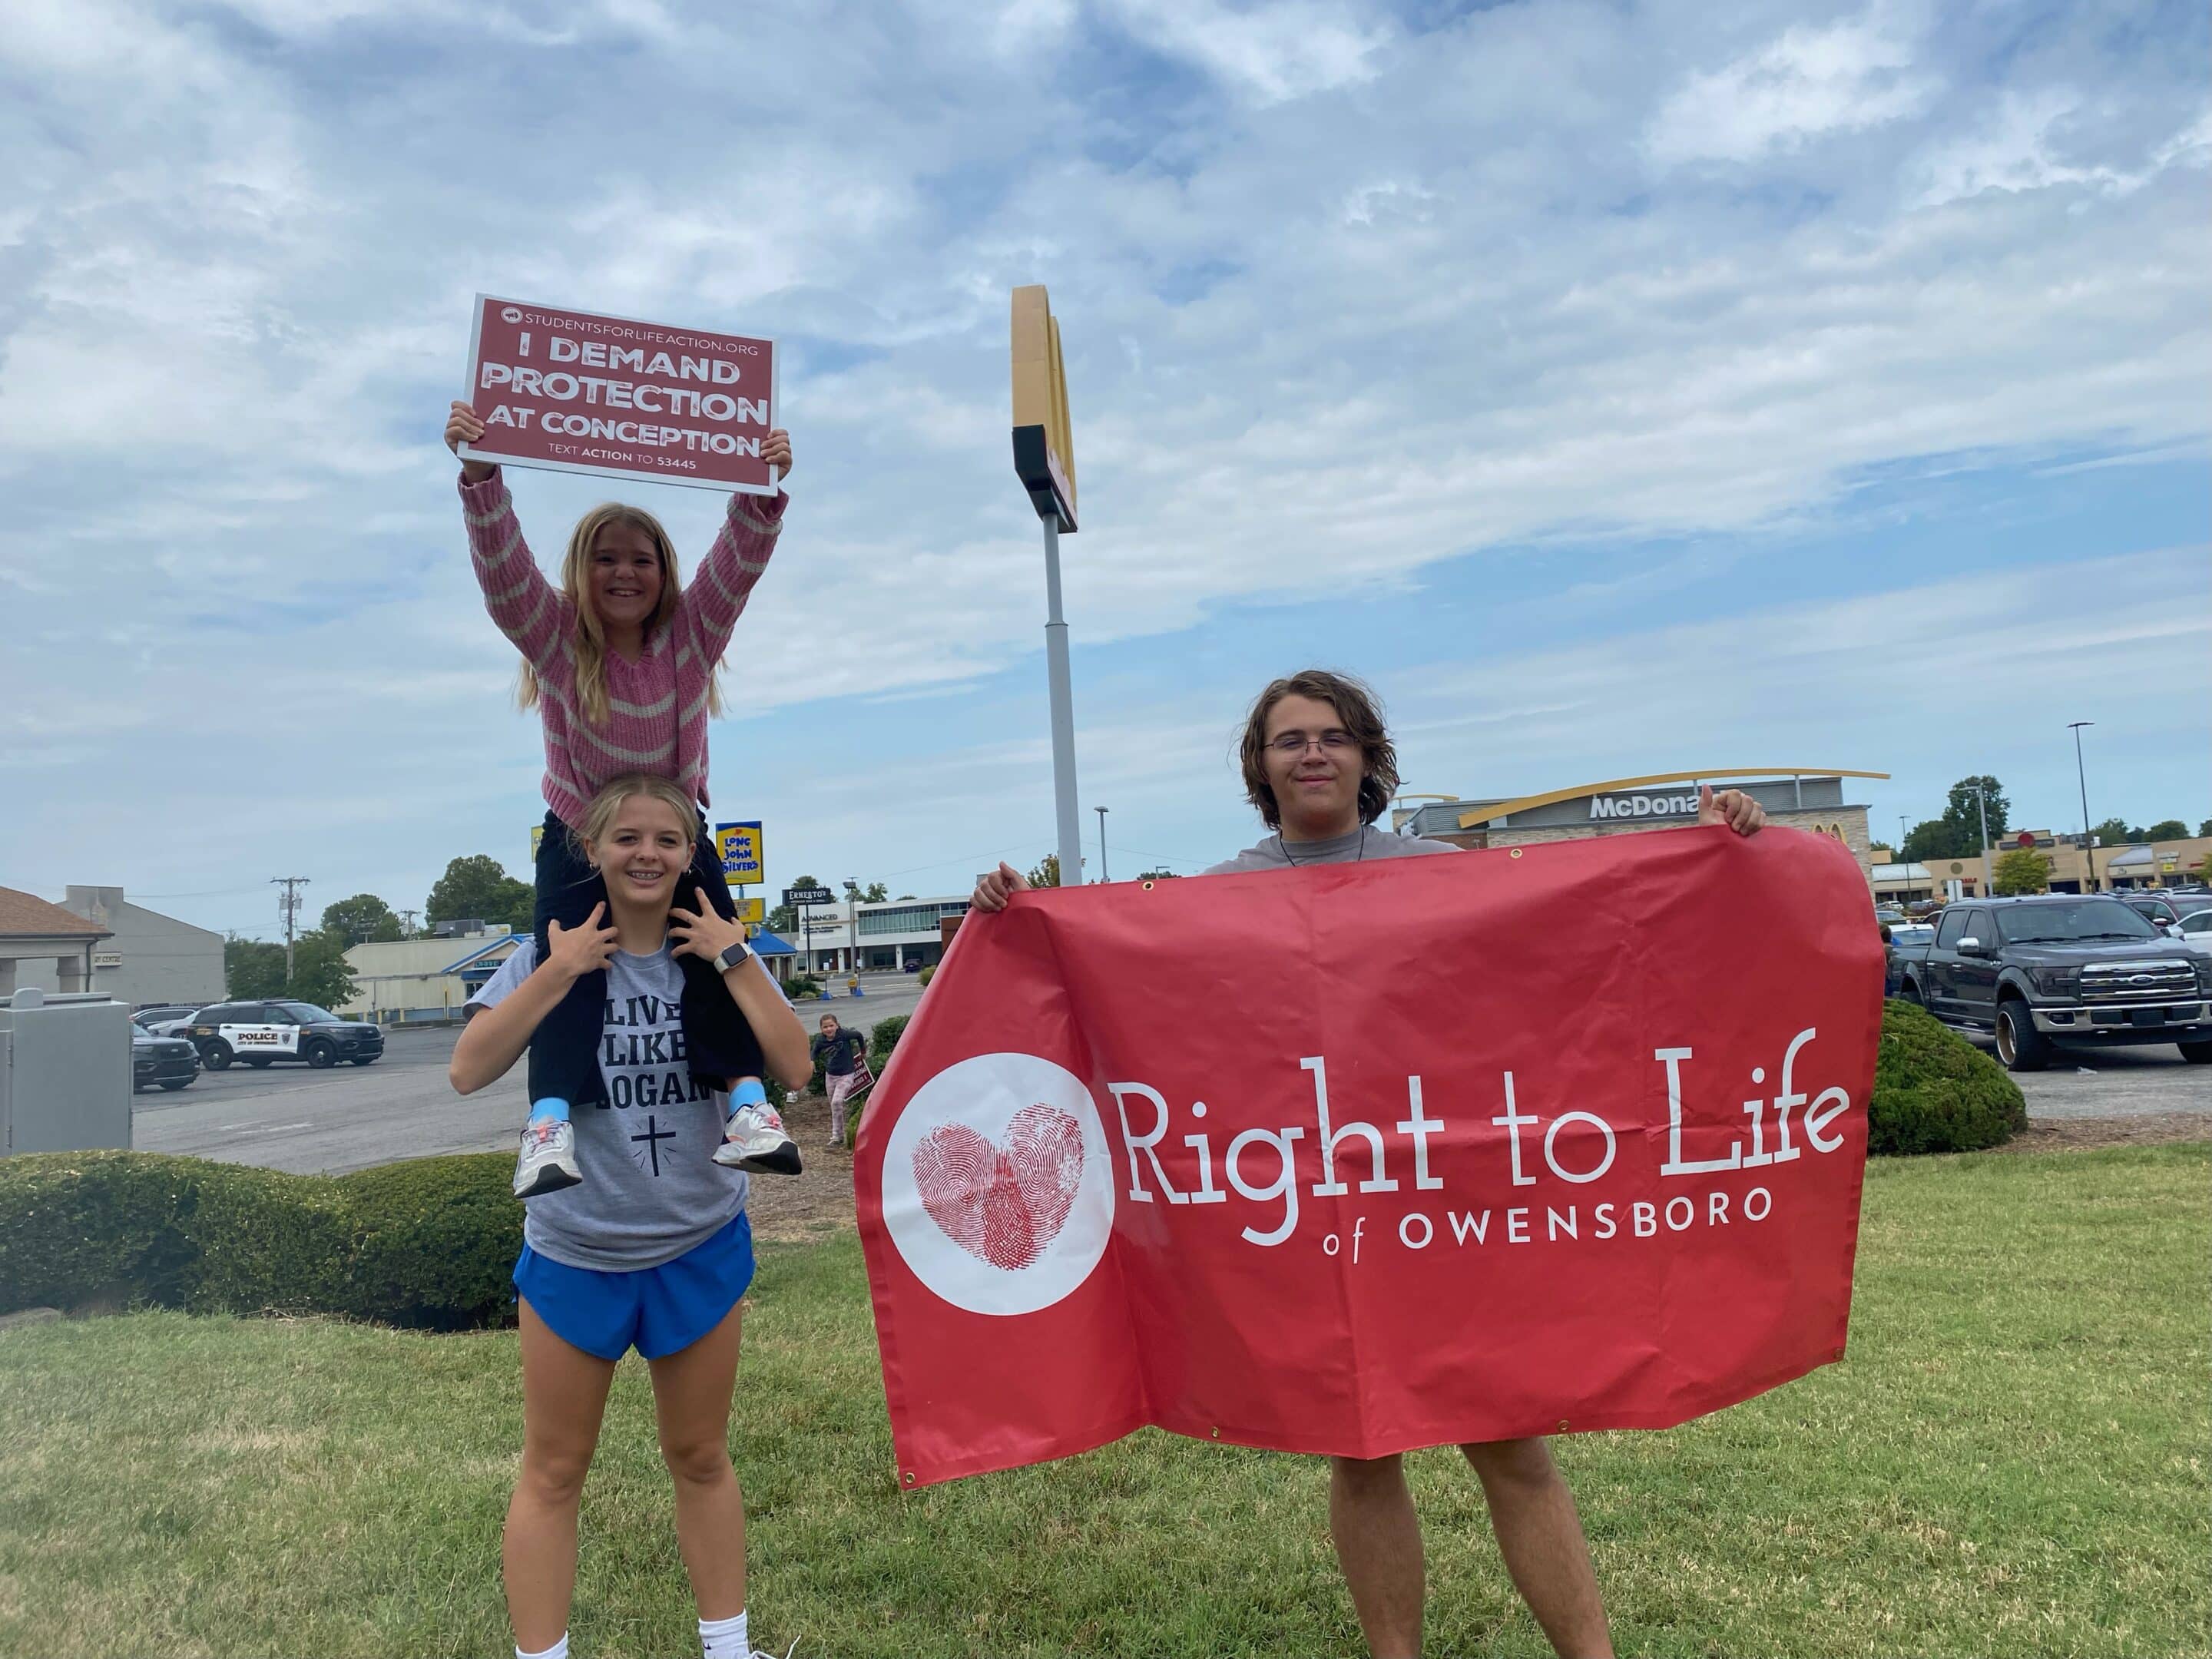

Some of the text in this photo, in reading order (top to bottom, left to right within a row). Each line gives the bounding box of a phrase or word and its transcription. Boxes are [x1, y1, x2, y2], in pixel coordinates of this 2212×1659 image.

[525, 313, 758, 356] STUDENTSFORLIFEACTION.ORG
[518, 332, 740, 384] I DEMAND
[481, 362, 767, 426] PROTECTION
[486, 405, 760, 459] AT CONCEPTION
[548, 442, 697, 470] TEXT ACTION TO 53445
[1590, 794, 1700, 818] McDona
[724, 837, 750, 847] LONG
[604, 995, 681, 1027] LIVE
[604, 1029, 687, 1067] LIKE
[596, 1071, 710, 1110] OGAN
[1108, 1027, 1851, 1247] Right to Life
[1322, 1187, 1772, 1264] of OWENSBORO
